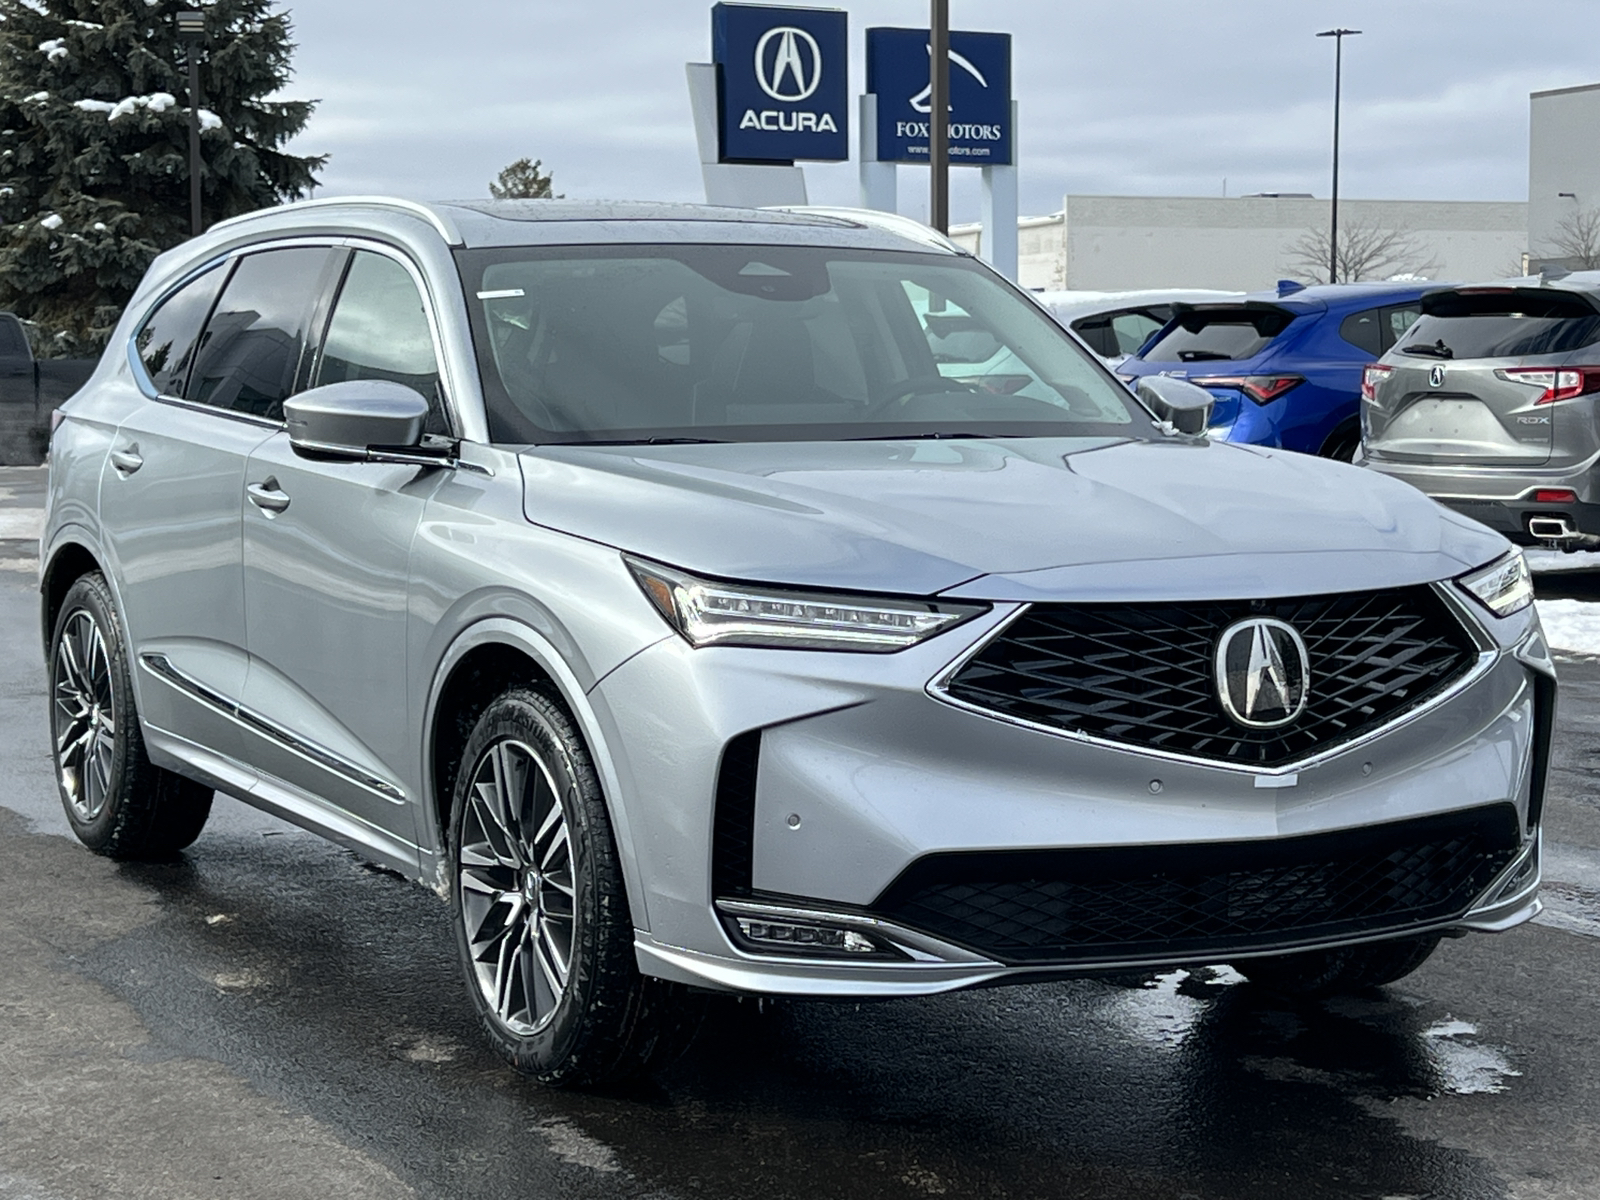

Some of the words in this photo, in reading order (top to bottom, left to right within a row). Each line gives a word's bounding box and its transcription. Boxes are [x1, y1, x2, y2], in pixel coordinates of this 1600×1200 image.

[739, 109, 838, 133] ACURA
[896, 121, 930, 138] FOX
[947, 123, 1002, 141] OTORS
[1516, 416, 1550, 424] RDX
